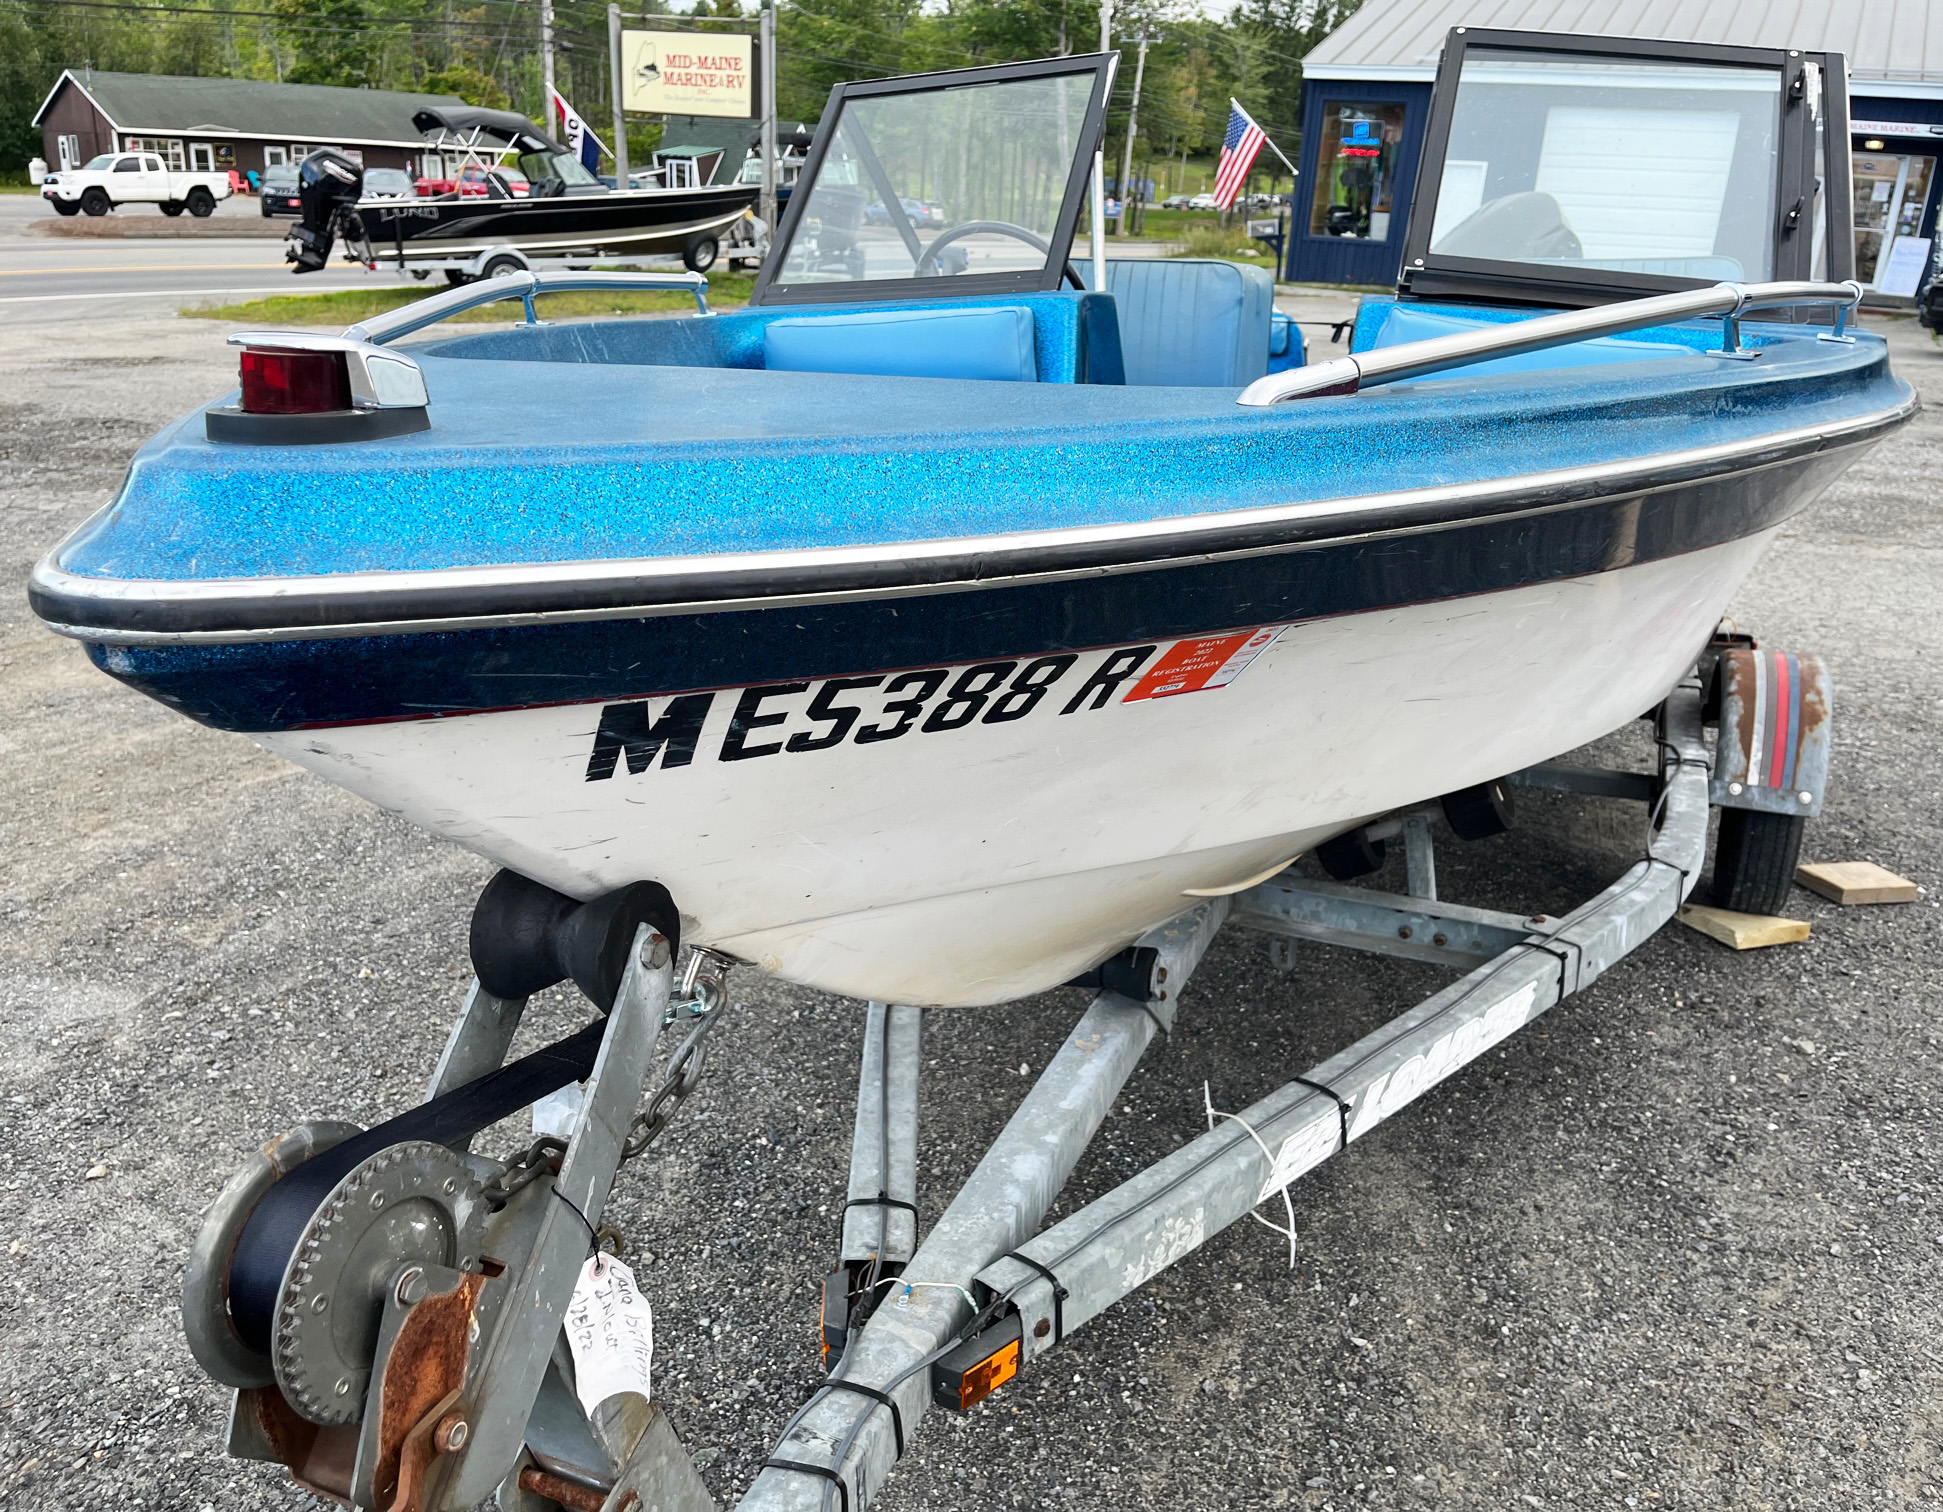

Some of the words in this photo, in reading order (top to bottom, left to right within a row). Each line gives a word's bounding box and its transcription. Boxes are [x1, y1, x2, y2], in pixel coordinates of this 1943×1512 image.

[666, 54, 742, 71] MID-MAINE
[379, 206, 440, 223] LUND
[1196, 639, 1228, 648] MAINE
[1151, 659, 1222, 678] REGISTRATION
[1181, 655, 1208, 665] BOAT
